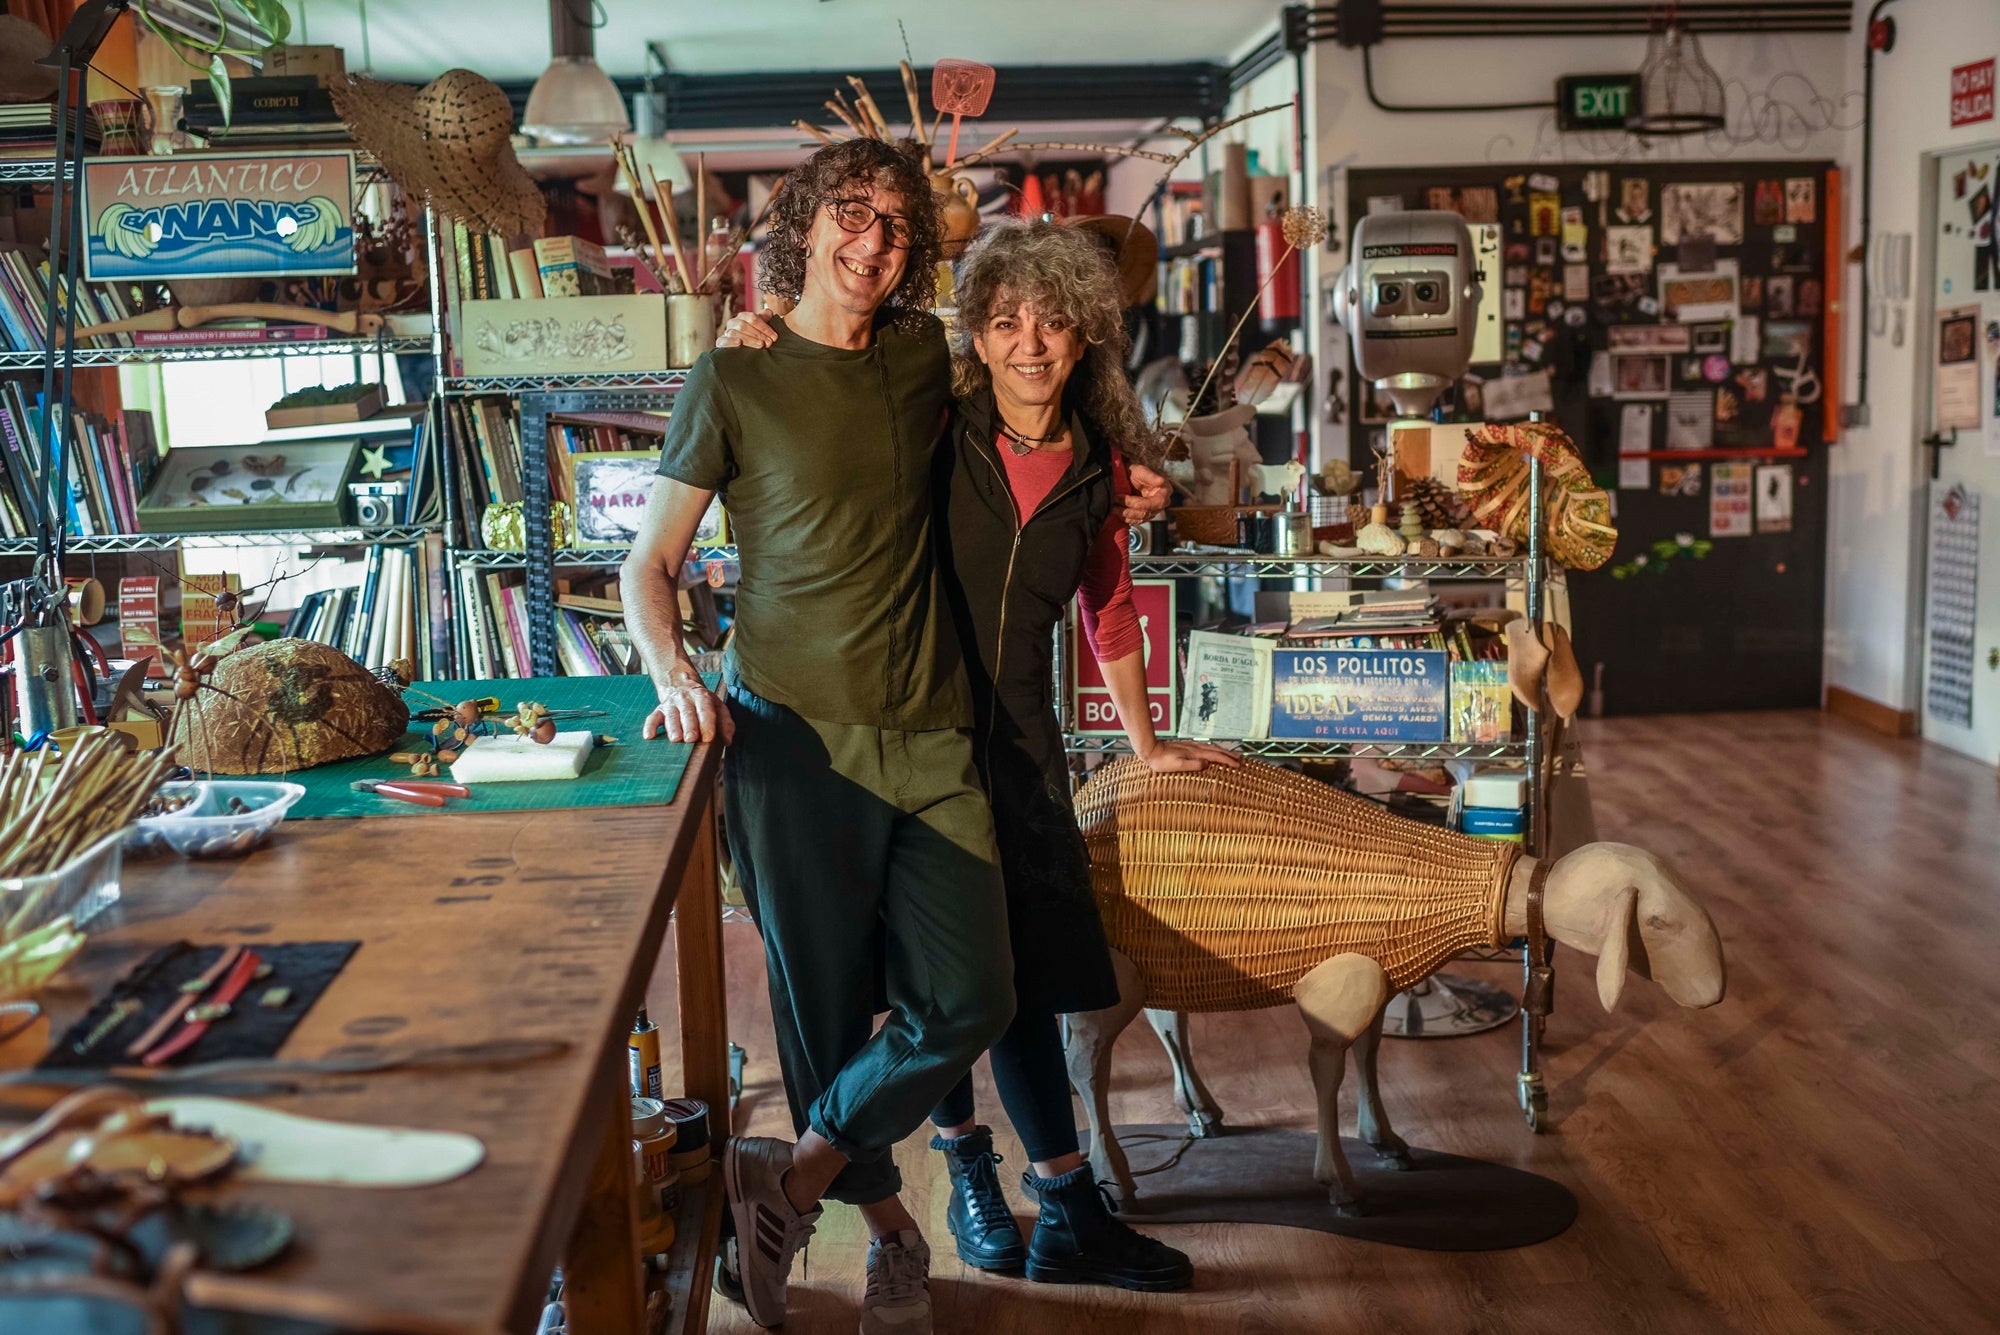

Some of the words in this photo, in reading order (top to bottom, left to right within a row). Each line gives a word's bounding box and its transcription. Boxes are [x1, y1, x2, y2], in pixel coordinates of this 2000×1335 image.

[1952, 70, 1968, 95] NO
[1970, 65, 1994, 90] HAY
[253, 96, 287, 109] GRECO
[1575, 86, 1629, 118] EXIT
[1952, 93, 1992, 120] SALIDA
[117, 161, 322, 196] ATLANTICO
[120, 199, 320, 241] BANANAS
[0, 408, 20, 452] Mucha
[1203, 653, 1229, 664] BORDA
[1294, 657, 1328, 675] LOS
[1337, 657, 1426, 676] POLLITOS
[1315, 727, 1329, 735] DE
[1335, 727, 1368, 736] VENTA
